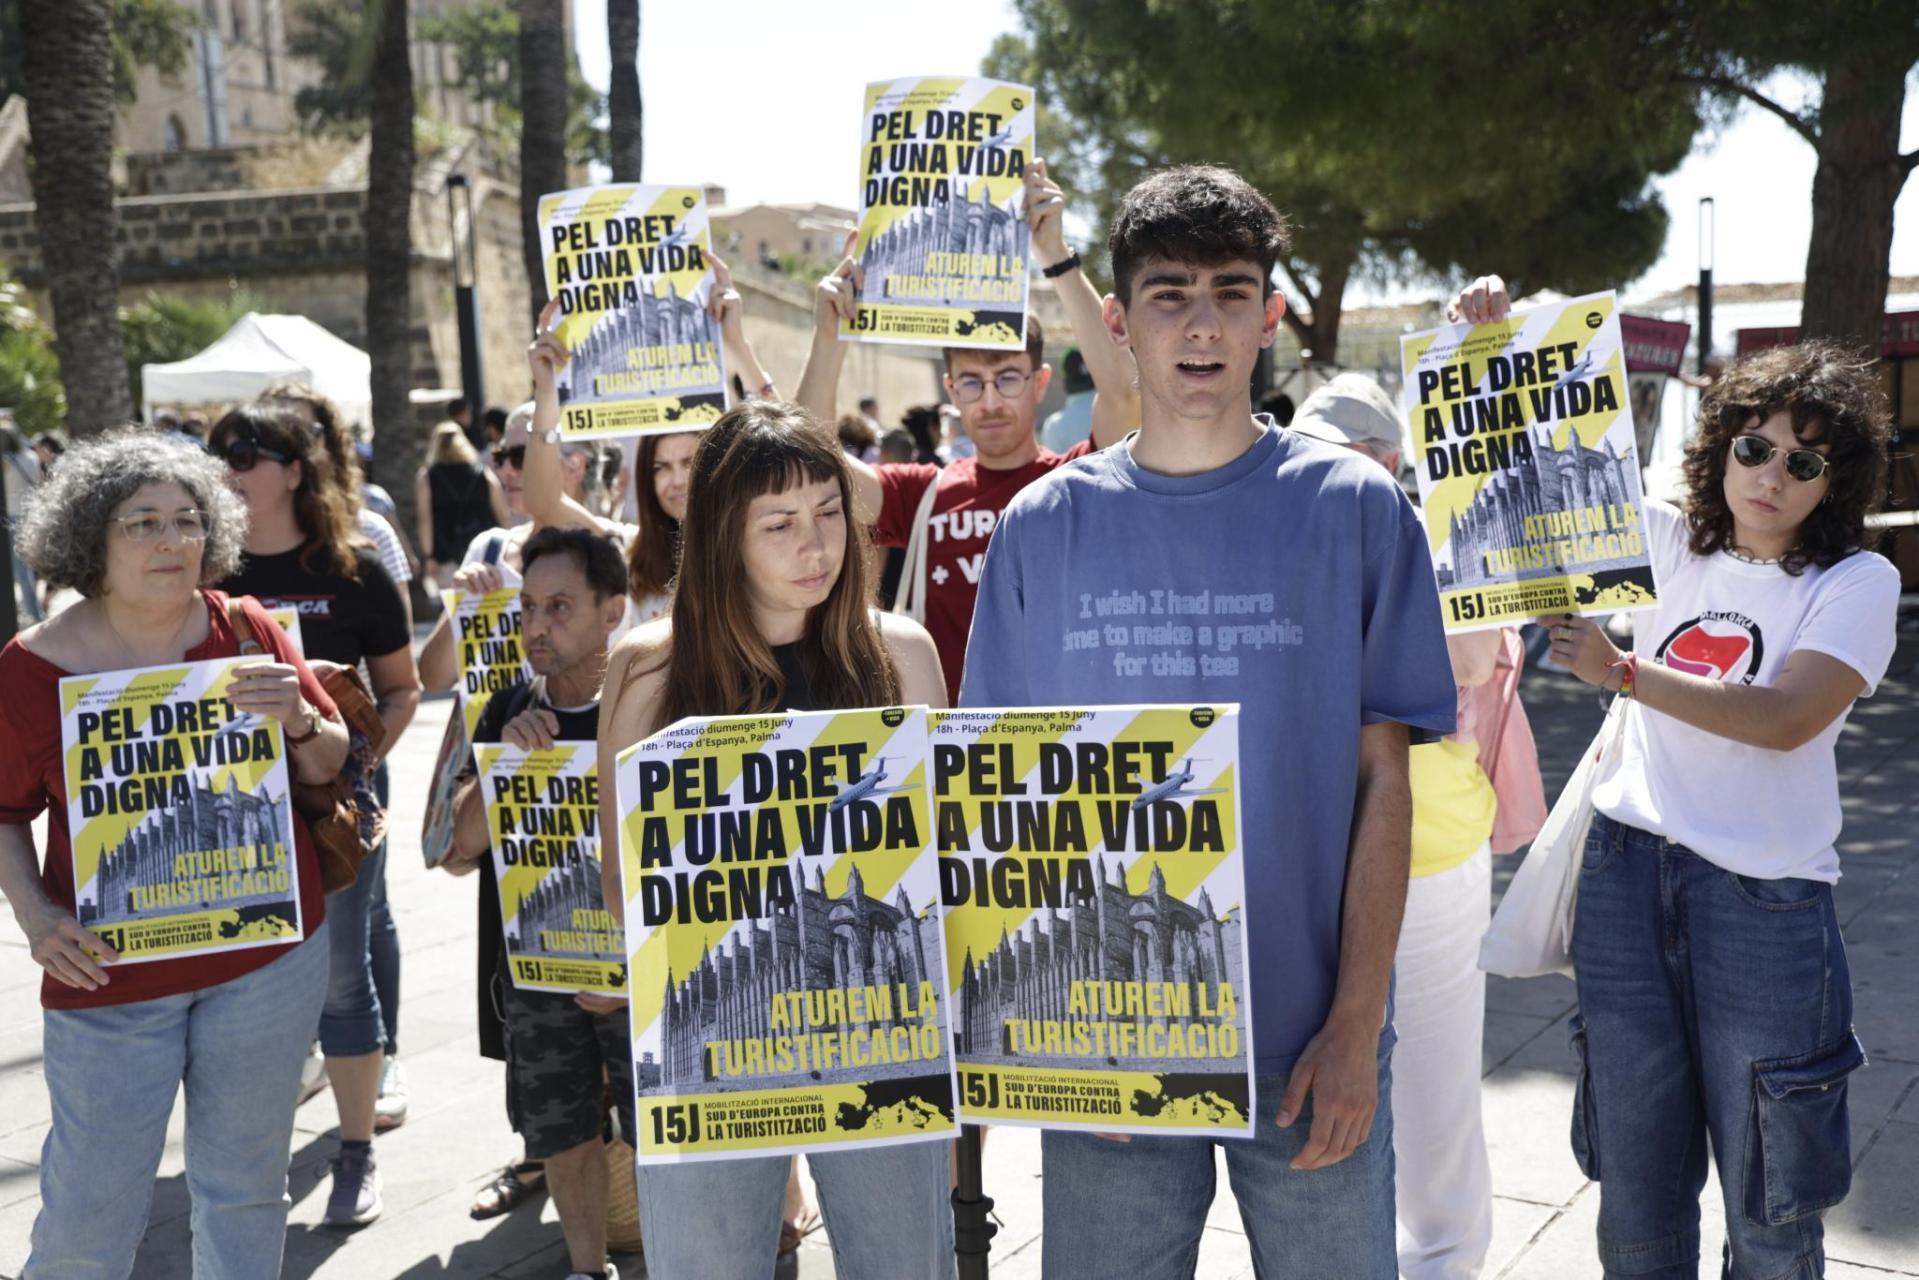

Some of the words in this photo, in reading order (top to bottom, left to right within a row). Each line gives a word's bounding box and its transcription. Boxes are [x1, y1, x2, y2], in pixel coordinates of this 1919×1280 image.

[871, 110, 917, 142] PEL
[925, 110, 1003, 143] DRET
[868, 146, 882, 175] A
[889, 143, 948, 174] UNA
[956, 146, 1025, 179] VIDA
[865, 177, 949, 208] DIGNA
[552, 222, 598, 253] PEL
[605, 215, 676, 246] DRET
[557, 256, 571, 284] A
[577, 250, 633, 281] UNA
[638, 245, 706, 275] VIDA
[927, 252, 997, 277] ATUREM
[1002, 254, 1023, 276] LA
[558, 281, 639, 315] DIGNA
[628, 342, 693, 367] ATUREM
[698, 341, 717, 363] LA
[1418, 361, 1481, 405] PEL
[1487, 341, 1578, 393] DRET
[567, 409, 592, 430] 15J
[1424, 407, 1447, 443] A
[1451, 390, 1525, 437] UNA
[1528, 375, 1618, 424] VIDA
[1425, 431, 1534, 482] DIGNA
[928, 509, 1003, 543] TUR
[1523, 506, 1607, 541] ATUREM
[1612, 500, 1639, 529] LA
[1485, 530, 1643, 575] TURISTIFICACIÓ
[1079, 592, 1092, 619] I
[1095, 590, 1146, 616] wish
[1150, 589, 1164, 615] I
[1168, 589, 1210, 615] had
[1214, 592, 1274, 615] more
[1449, 592, 1485, 622] 15J
[1489, 604, 1501, 616] LA
[460, 613, 495, 640] PEL
[1103, 624, 1128, 646] to
[1133, 621, 1193, 646] make
[1198, 626, 1212, 646] a
[1217, 618, 1303, 651] graphic
[464, 642, 476, 667] A
[480, 639, 520, 666] UNA
[1113, 651, 1147, 677] for
[1151, 649, 1196, 677] this
[1200, 653, 1239, 677] tee
[466, 667, 525, 694] DIGNA
[78, 706, 143, 744] PEL
[151, 697, 237, 736] DRET
[707, 721, 756, 734] diumenge
[758, 719, 769, 729] 15
[771, 718, 794, 730] Juny
[936, 725, 953, 734] 18h
[961, 724, 988, 736] Plaça
[991, 723, 1047, 735] d'Espanya,
[1050, 722, 1082, 733] Palma
[1003, 710, 1056, 722] diumenge
[1059, 711, 1070, 719] 15
[1072, 710, 1096, 721] Juny
[80, 747, 104, 781] A
[110, 738, 185, 777] UNA
[190, 728, 275, 768] VIDA
[666, 740, 693, 751] Plaça
[696, 735, 748, 747] d'Espanya,
[750, 731, 781, 742] Palma
[638, 755, 731, 812] PEL
[742, 742, 868, 805] DRET
[933, 743, 1027, 796] PEL
[1039, 741, 1174, 795] DRET
[80, 774, 192, 818] DIGNA
[492, 775, 542, 804] PEL
[547, 775, 599, 805] DRE
[499, 806, 516, 835] A
[520, 807, 576, 837] UNA
[640, 816, 673, 869] A
[684, 807, 788, 866] UNA
[795, 796, 921, 857] VIDA
[937, 801, 971, 852] A
[980, 800, 1088, 852] UNA
[1096, 799, 1225, 852] VIDA
[174, 844, 258, 877] ATUREM
[262, 842, 287, 867] LA
[501, 838, 581, 868] DIGNA
[129, 868, 289, 912] TURISTIFICACIÓ
[640, 864, 797, 927] DIGNA
[938, 856, 1098, 909] DIGNA
[129, 940, 142, 951] LA
[517, 960, 542, 981] 15J
[770, 984, 892, 1029] ATUREM
[898, 981, 938, 1019] LA
[1069, 980, 1190, 1016] ATUREM
[1199, 981, 1237, 1017] LA
[705, 1016, 941, 1078] TURISTIFICACIÓ
[1005, 1018, 1239, 1058] TURISTIFICACIÓ
[1003, 1074, 1057, 1084] MOBILITZACIÓ
[1058, 1076, 1120, 1086] INTERNACIONAL
[1005, 1082, 1025, 1092] SUD
[1027, 1083, 1077, 1095] D'EUROPA
[1079, 1086, 1120, 1097] CONTRA
[704, 1098, 759, 1109] MOBILITZACIÓ
[761, 1094, 824, 1105] INTERNACIONAL
[706, 1110, 726, 1121] SUD
[729, 1107, 781, 1120] D'EUROPA
[783, 1103, 825, 1116] CONTRA
[1006, 1094, 1022, 1109] LA
[1024, 1094, 1122, 1115] TURISTITZACIÓ
[650, 1103, 701, 1145] 15J
[707, 1123, 724, 1141] LA
[726, 1114, 827, 1139] TURISTITZACIÓ
